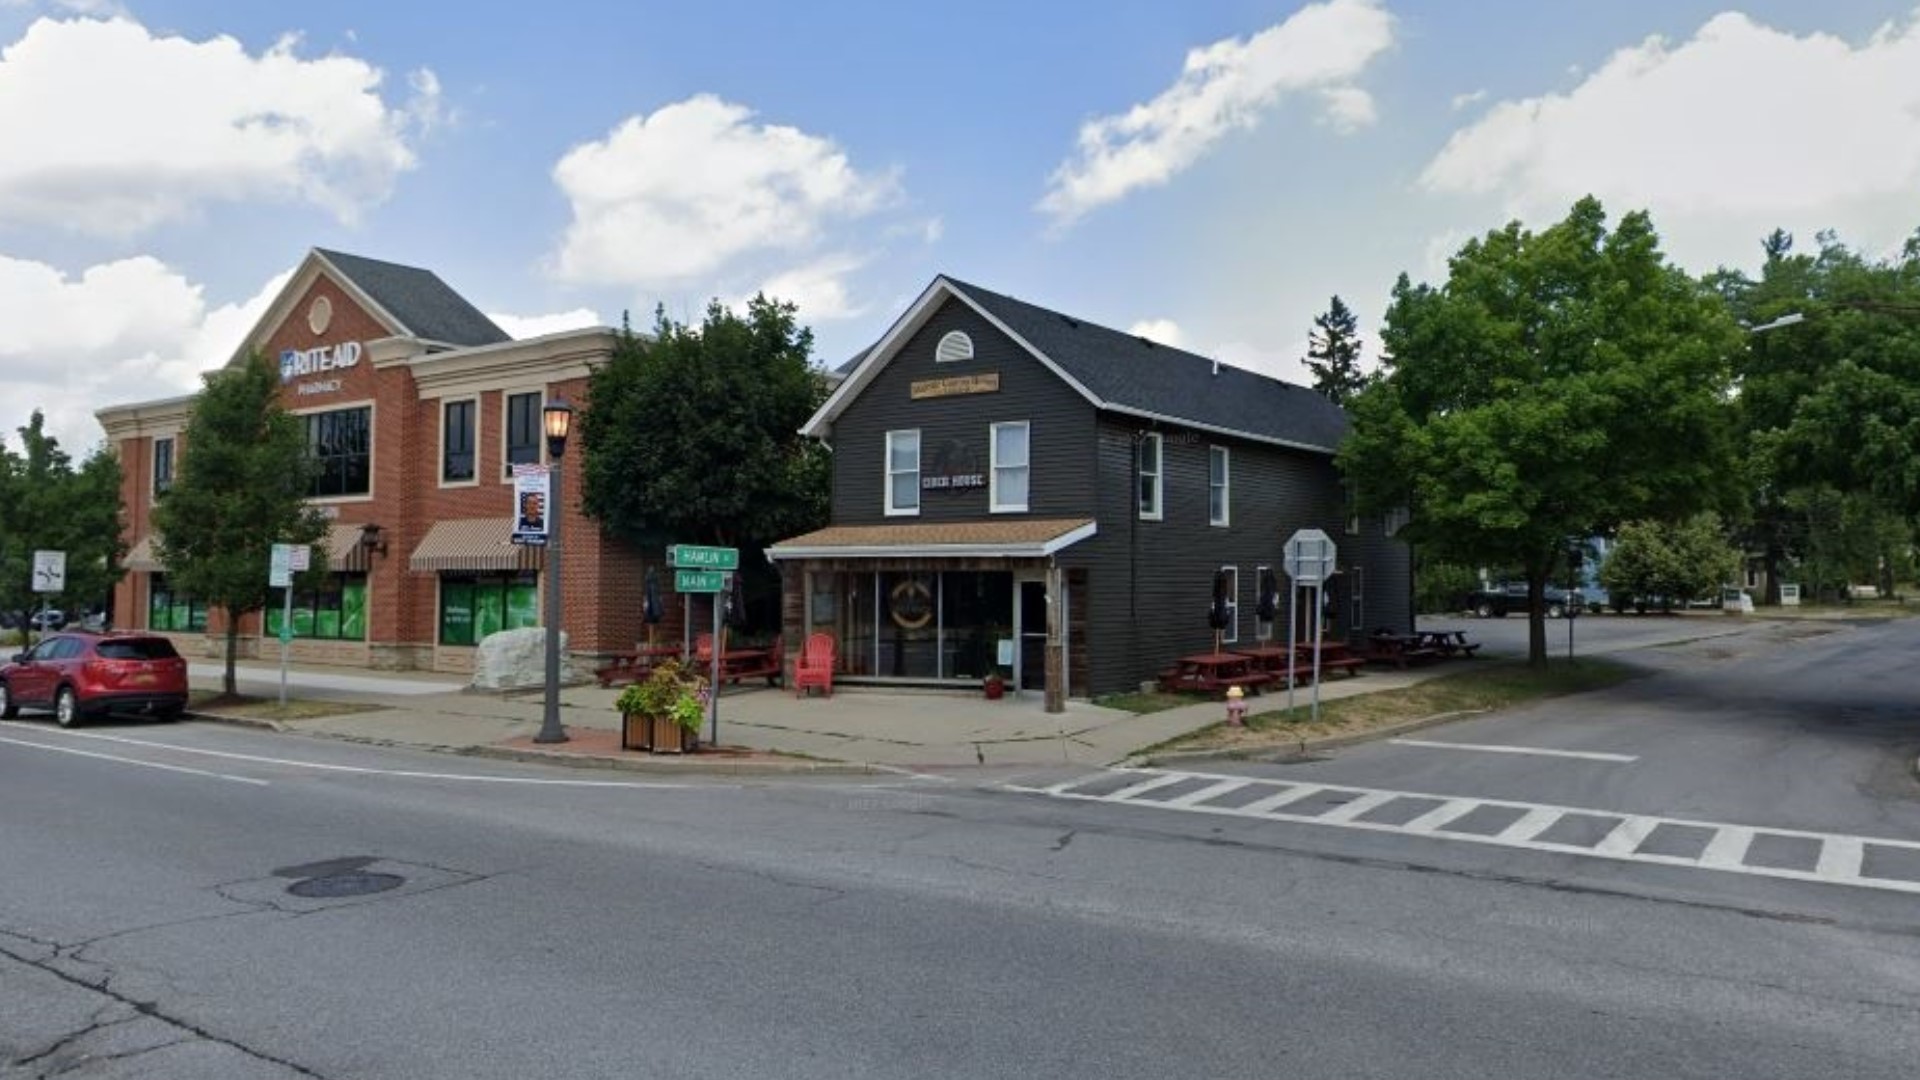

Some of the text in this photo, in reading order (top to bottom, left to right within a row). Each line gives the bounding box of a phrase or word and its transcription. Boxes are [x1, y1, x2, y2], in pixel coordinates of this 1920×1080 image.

[294, 342, 362, 375] RITE AID
[952, 475, 985, 487] HOUSE
[683, 549, 720, 564] HAMLIN
[682, 574, 707, 587] MAIN
